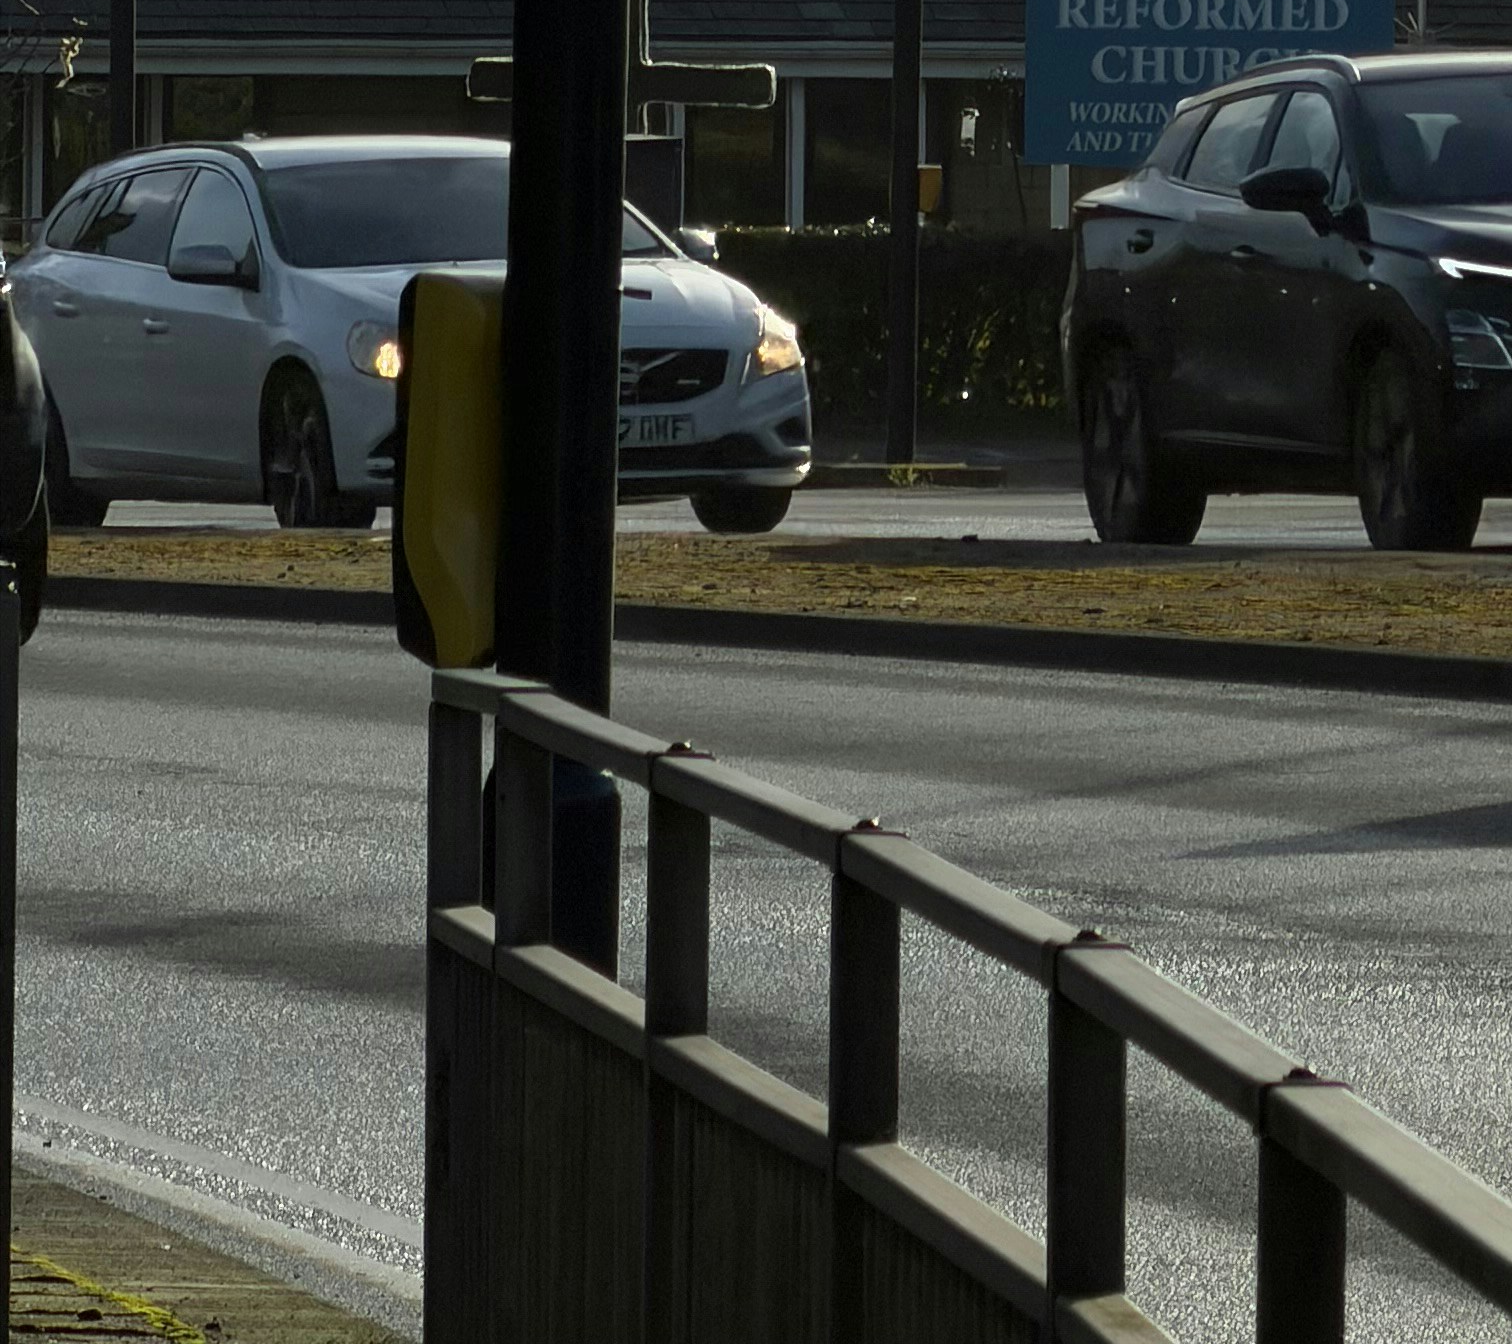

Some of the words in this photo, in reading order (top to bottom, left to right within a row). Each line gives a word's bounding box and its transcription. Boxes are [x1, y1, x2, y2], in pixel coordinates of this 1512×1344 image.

[1091, 44, 1310, 85] CHUR
[1066, 101, 1174, 125] WORKIN
[1066, 130, 1123, 153] AND
